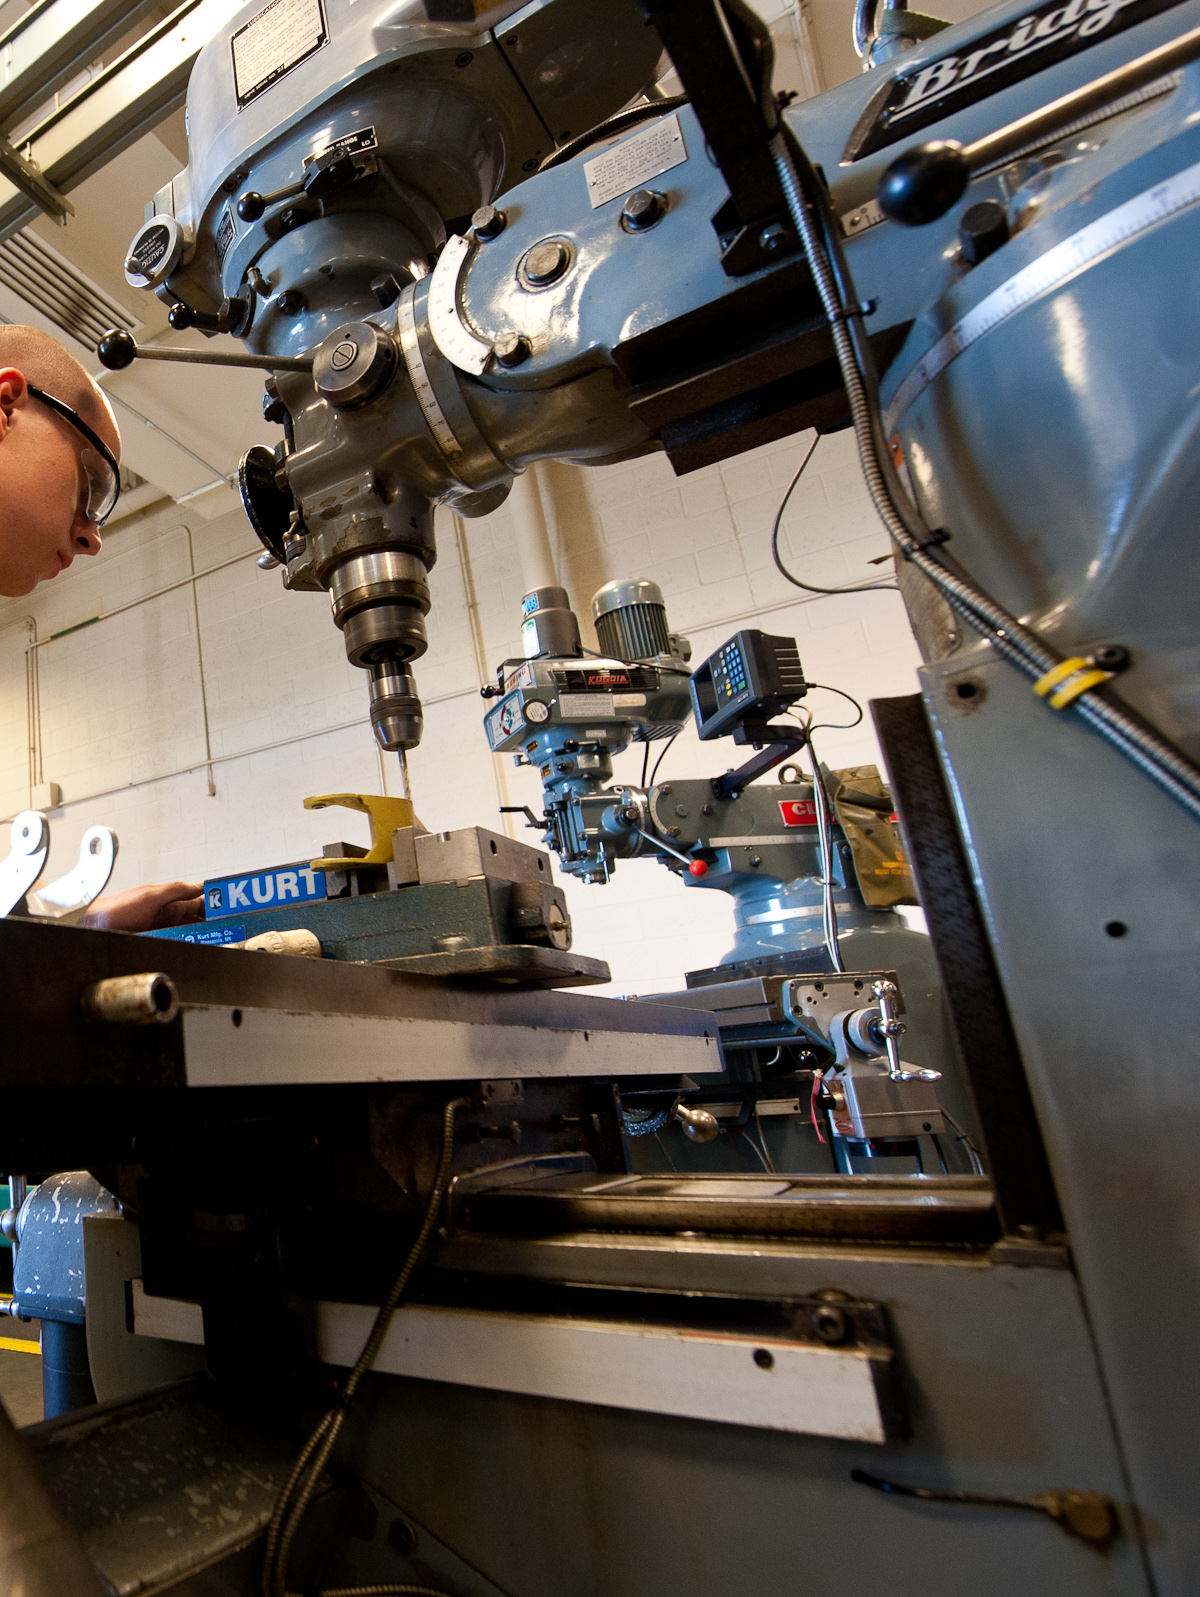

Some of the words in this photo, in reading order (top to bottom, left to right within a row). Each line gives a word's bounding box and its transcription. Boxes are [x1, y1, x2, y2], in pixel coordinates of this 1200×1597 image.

[141, 246, 165, 268] CAUTIO
[228, 867, 320, 909] KURT
[197, 932, 210, 940] Kurt
